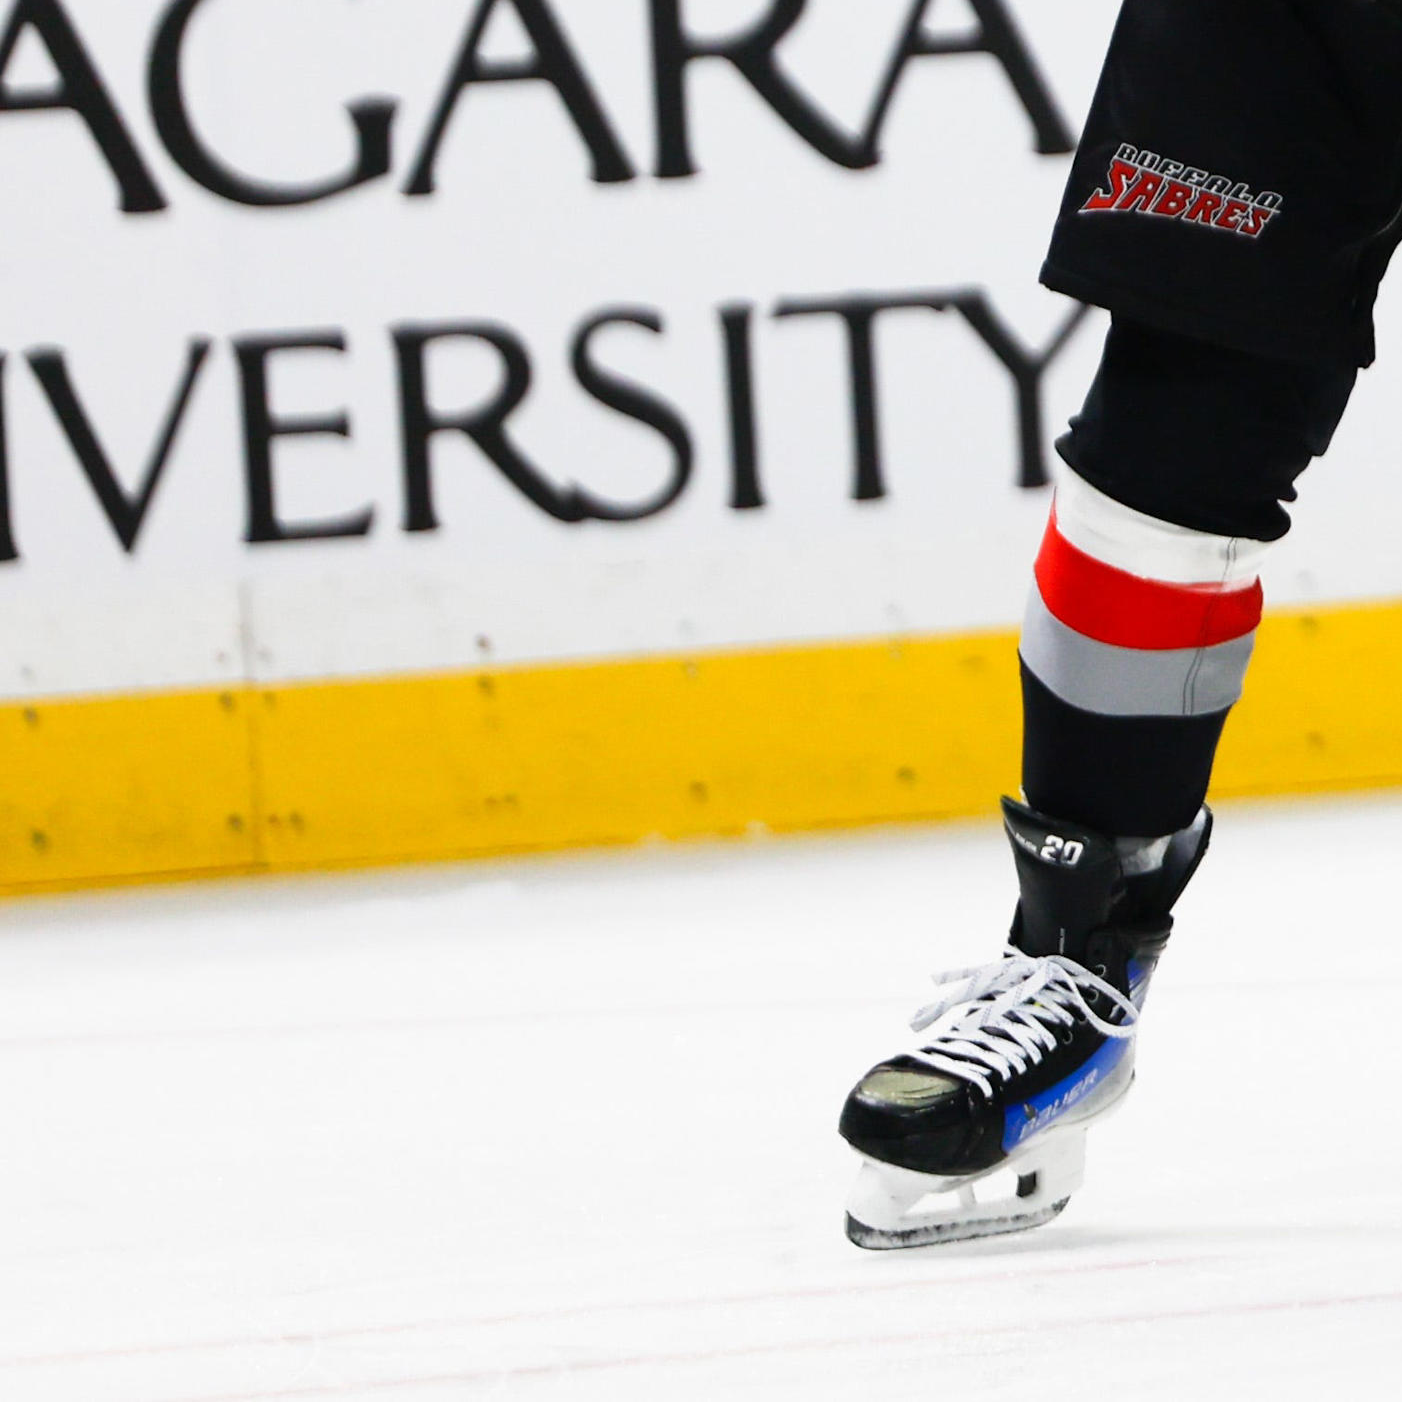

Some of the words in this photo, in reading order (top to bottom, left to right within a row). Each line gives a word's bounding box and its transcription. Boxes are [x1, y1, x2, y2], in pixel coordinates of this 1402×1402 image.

[1076, 156, 1280, 239] SABRES
[1115, 142, 1284, 212] BUFFALO
[1040, 833, 1085, 866] 20
